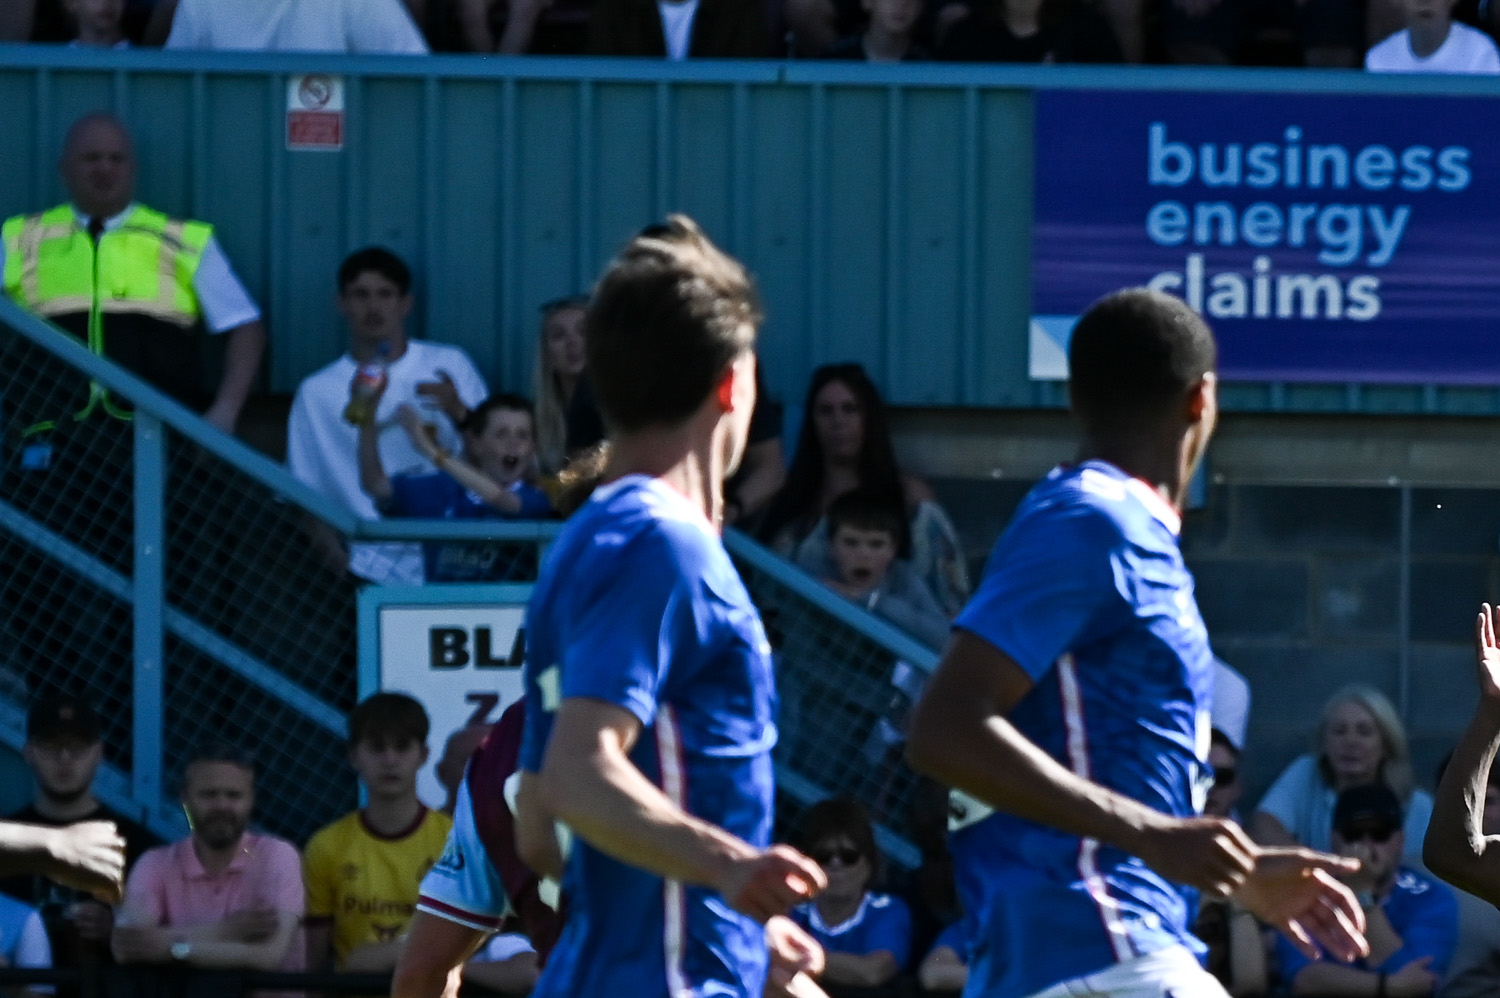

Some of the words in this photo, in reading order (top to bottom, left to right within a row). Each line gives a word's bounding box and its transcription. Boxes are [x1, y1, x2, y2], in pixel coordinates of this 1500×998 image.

[1147, 122, 1473, 191] business
[1146, 200, 1411, 267] energy
[1146, 253, 1382, 322] claims
